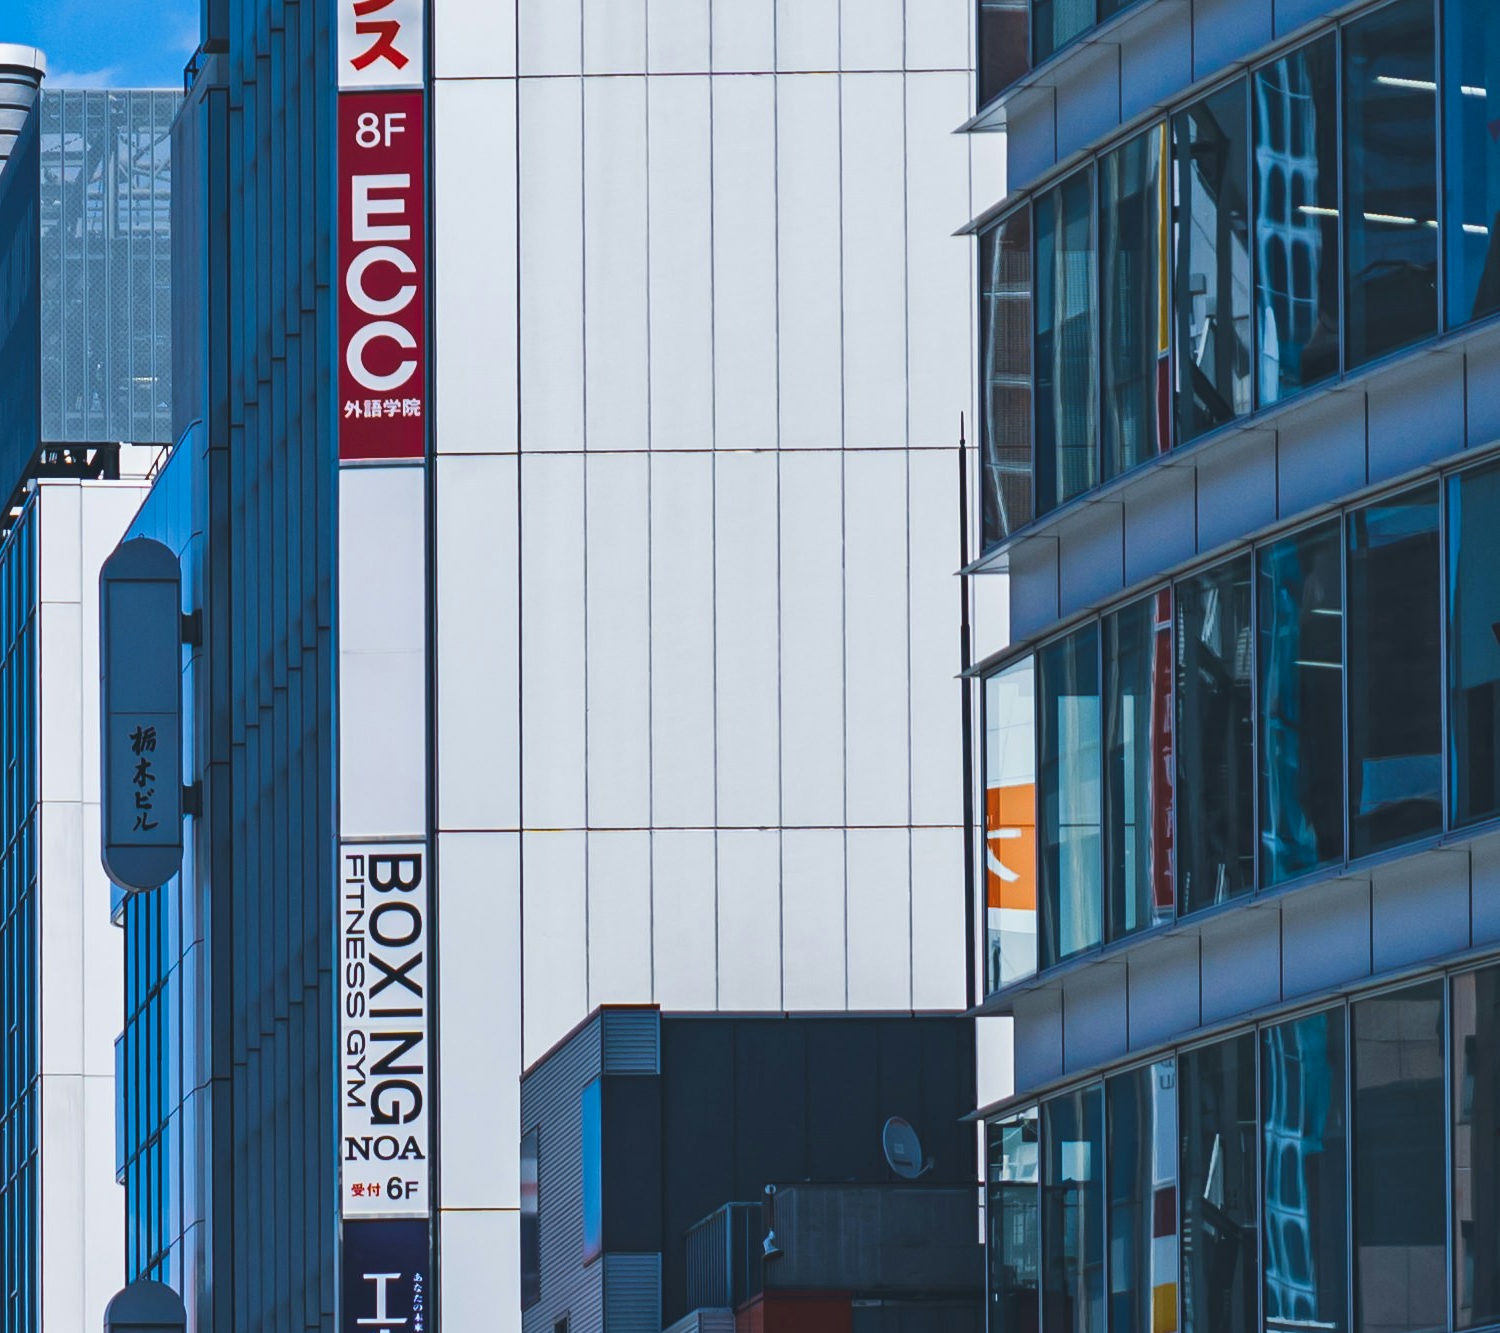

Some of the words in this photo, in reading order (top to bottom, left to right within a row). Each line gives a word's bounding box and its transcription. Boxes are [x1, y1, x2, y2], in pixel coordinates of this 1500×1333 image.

[354, 112, 407, 150] 8F
[345, 172, 418, 392] ECC
[343, 399, 421, 420] 外語学院
[128, 724, 159, 832] 栃木ビル
[344, 853, 365, 1020] FITNESS
[368, 853, 424, 1127] BOXING
[345, 1029, 366, 1109] GYM
[343, 1134, 426, 1162] NOA
[351, 1182, 382, 1198] 受付
[386, 1175, 420, 1202] 6F
